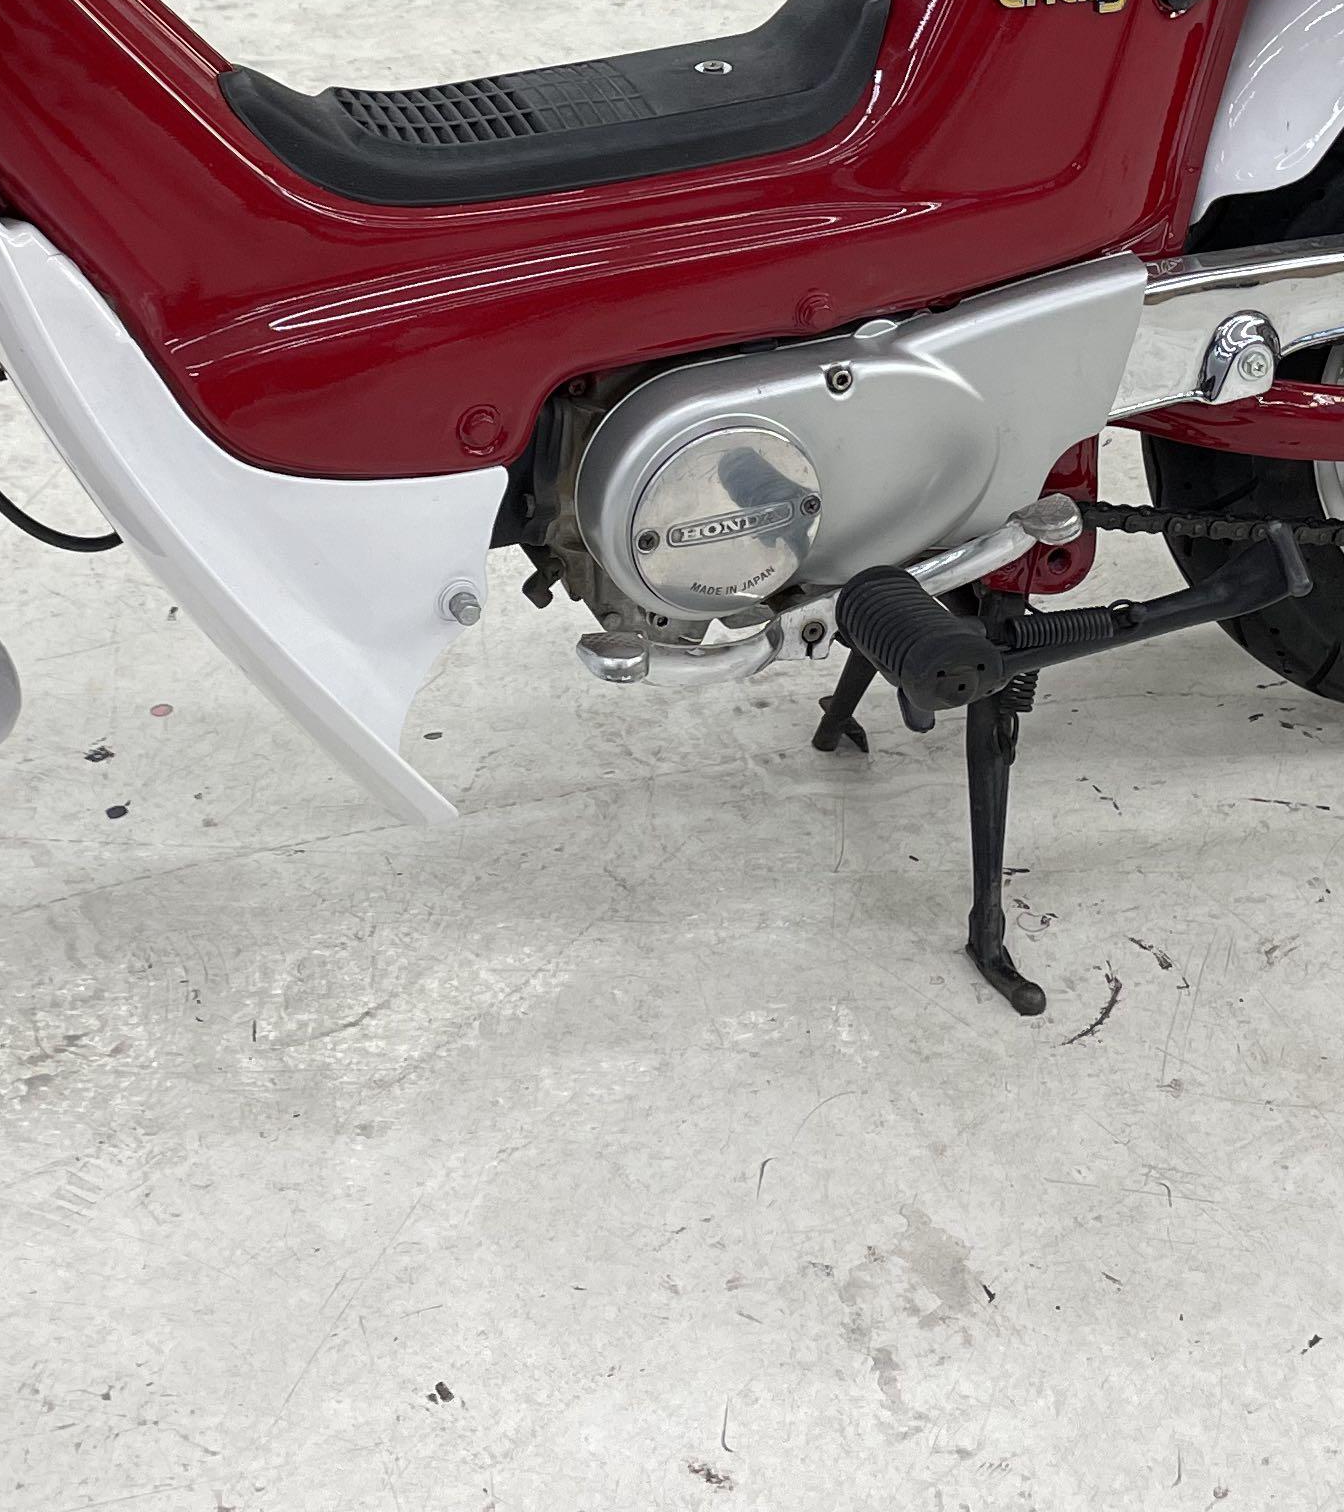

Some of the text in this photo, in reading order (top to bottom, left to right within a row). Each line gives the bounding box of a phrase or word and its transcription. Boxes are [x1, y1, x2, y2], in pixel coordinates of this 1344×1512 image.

[680, 507, 776, 541] HONDA
[690, 565, 776, 596] MADE IN JAPAN
